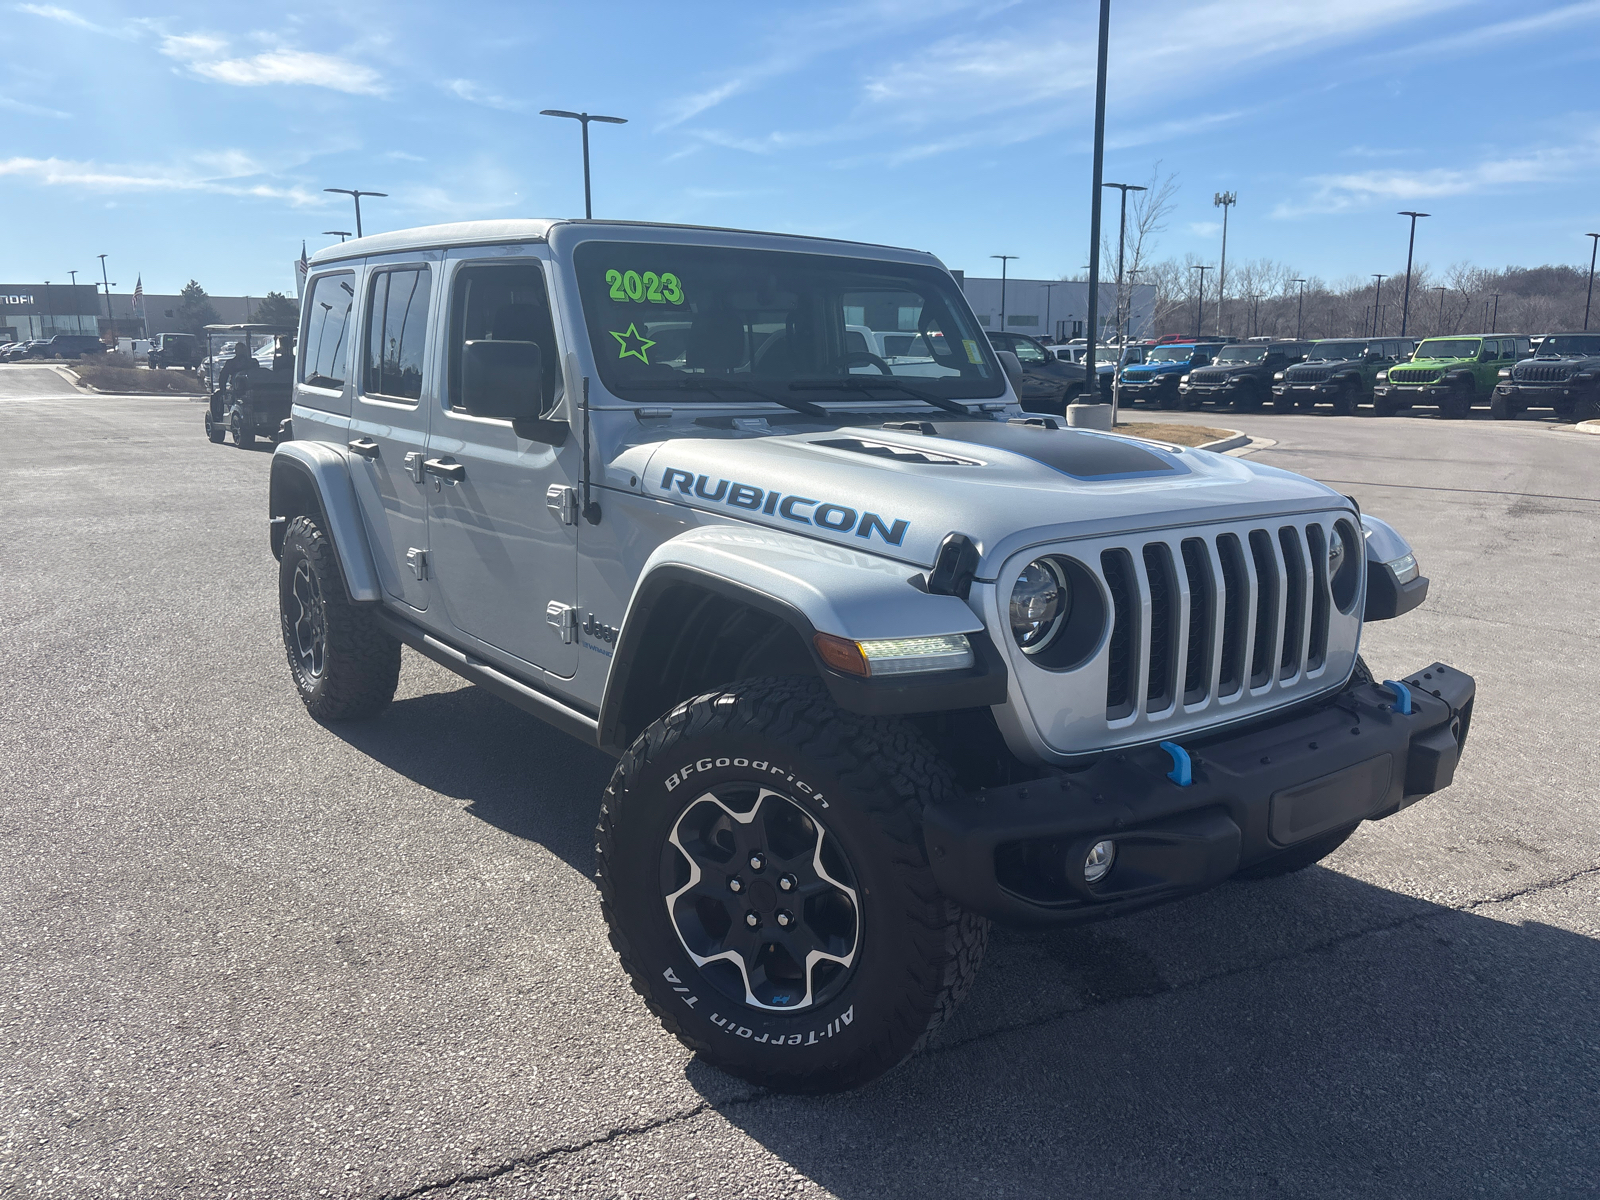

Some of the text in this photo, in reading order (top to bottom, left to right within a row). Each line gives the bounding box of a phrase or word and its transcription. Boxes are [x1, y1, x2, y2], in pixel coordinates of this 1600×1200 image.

[605, 269, 684, 305] 2023
[660, 466, 911, 547] RUBICON
[664, 757, 830, 809] BFGoodrich
[662, 966, 854, 1046] All-Terrain T/A
